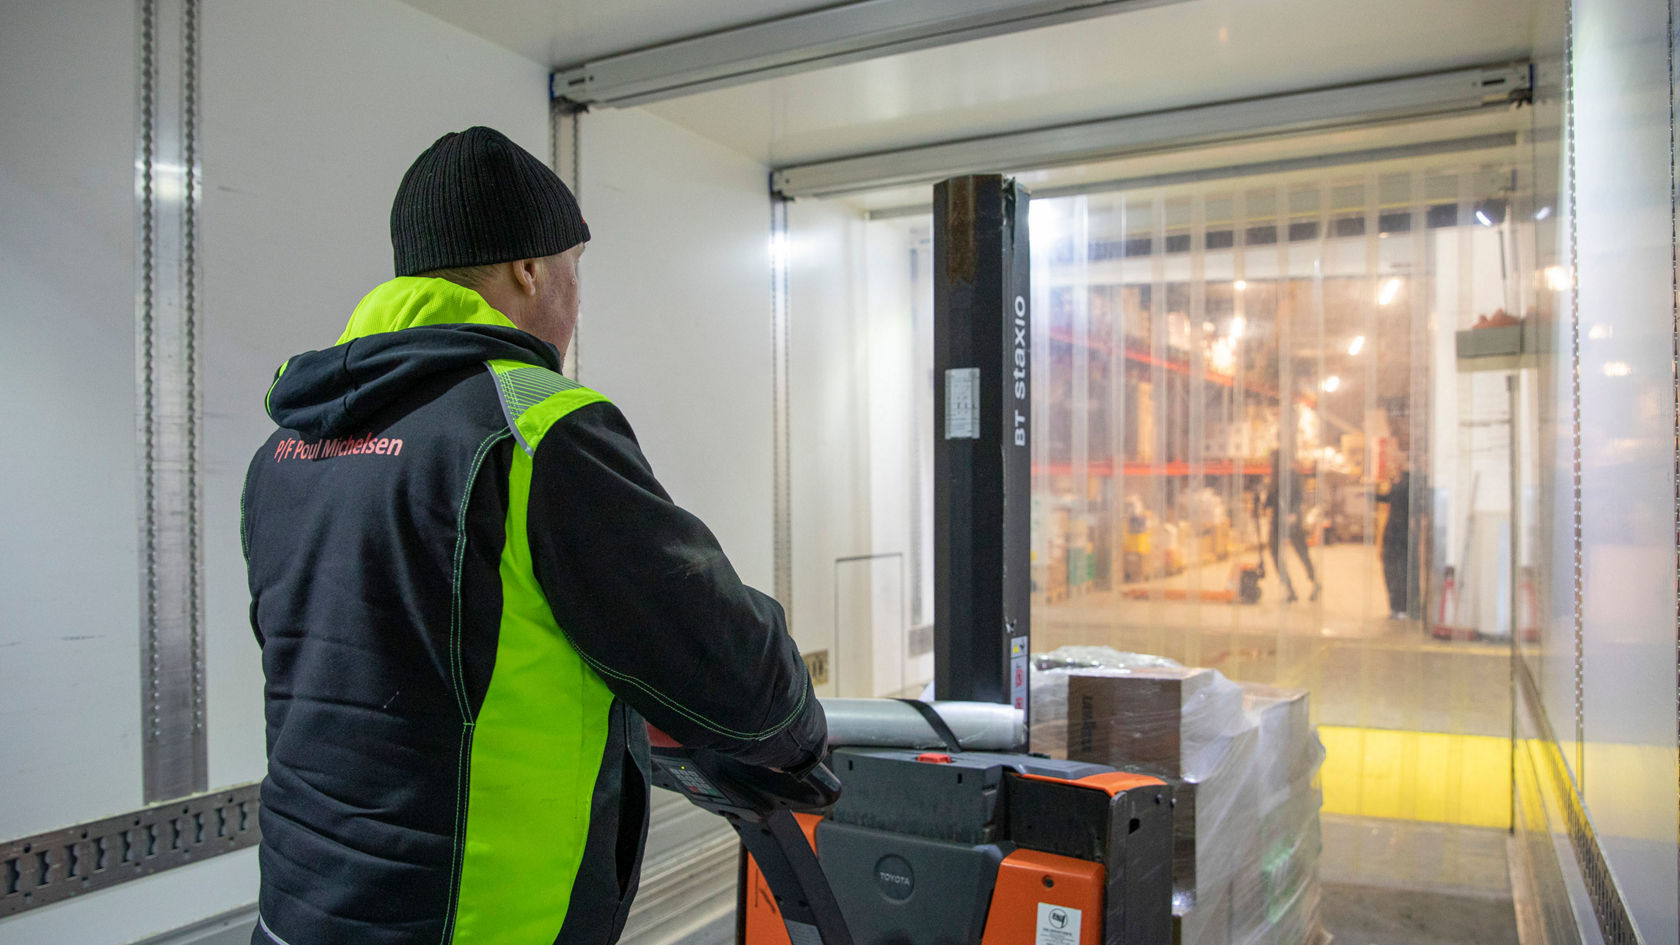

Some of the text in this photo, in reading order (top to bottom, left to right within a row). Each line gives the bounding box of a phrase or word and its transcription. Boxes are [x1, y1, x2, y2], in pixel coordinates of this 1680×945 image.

[1014, 409, 1026, 446] BT
[274, 431, 404, 463] P/F Poul Michelsen
[879, 871, 911, 887] TOYOTA
